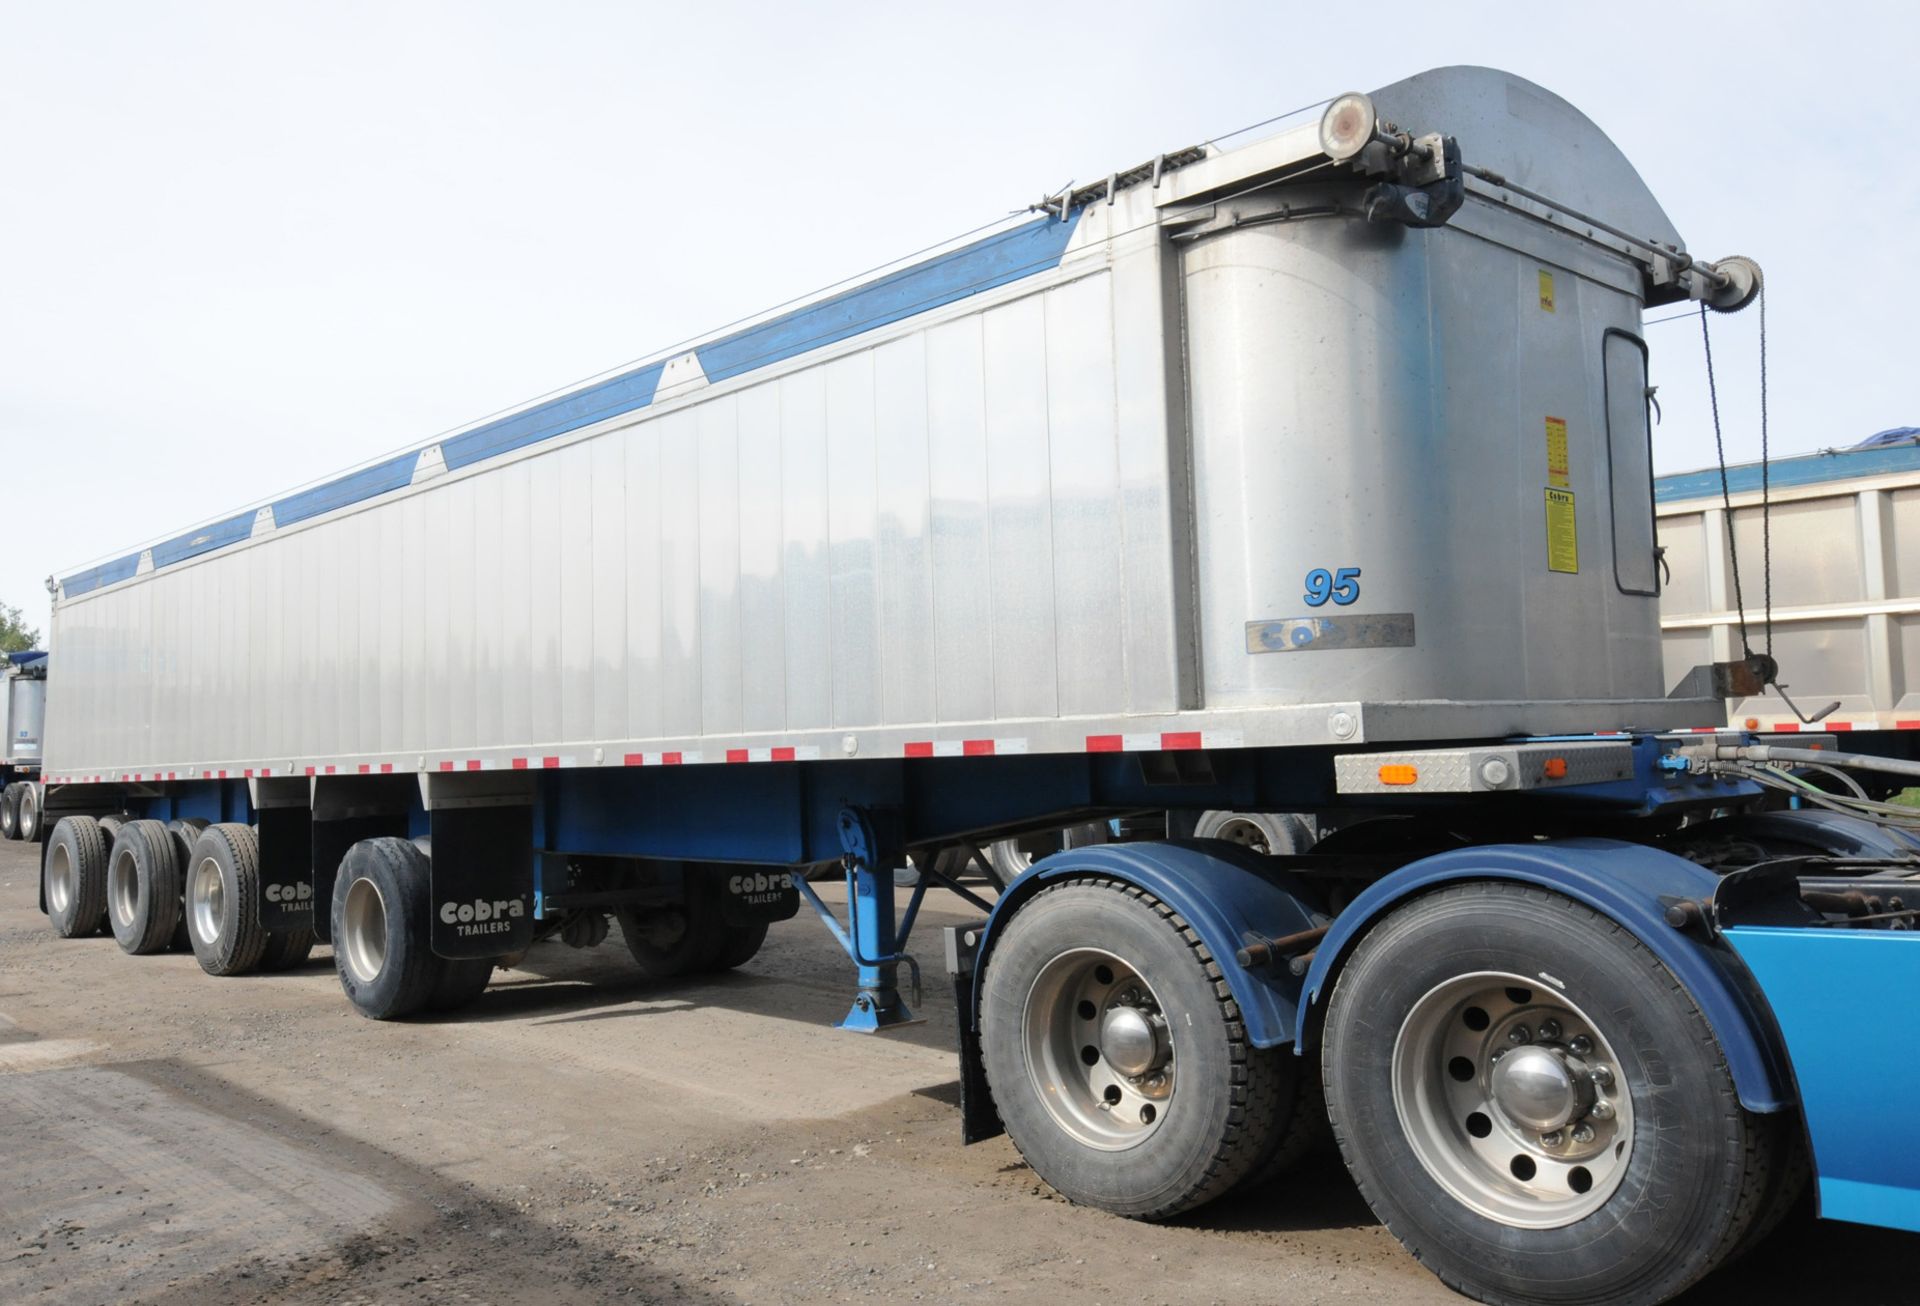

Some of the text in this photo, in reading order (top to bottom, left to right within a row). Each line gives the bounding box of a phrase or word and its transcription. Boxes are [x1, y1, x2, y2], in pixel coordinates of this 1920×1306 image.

[1303, 567, 1361, 607] 95
[265, 881, 312, 902] Cob
[729, 872, 793, 894] Cobra
[280, 901, 313, 912] TRAIL
[440, 899, 524, 924] Cobra
[457, 921, 511, 936] TRAILERS
